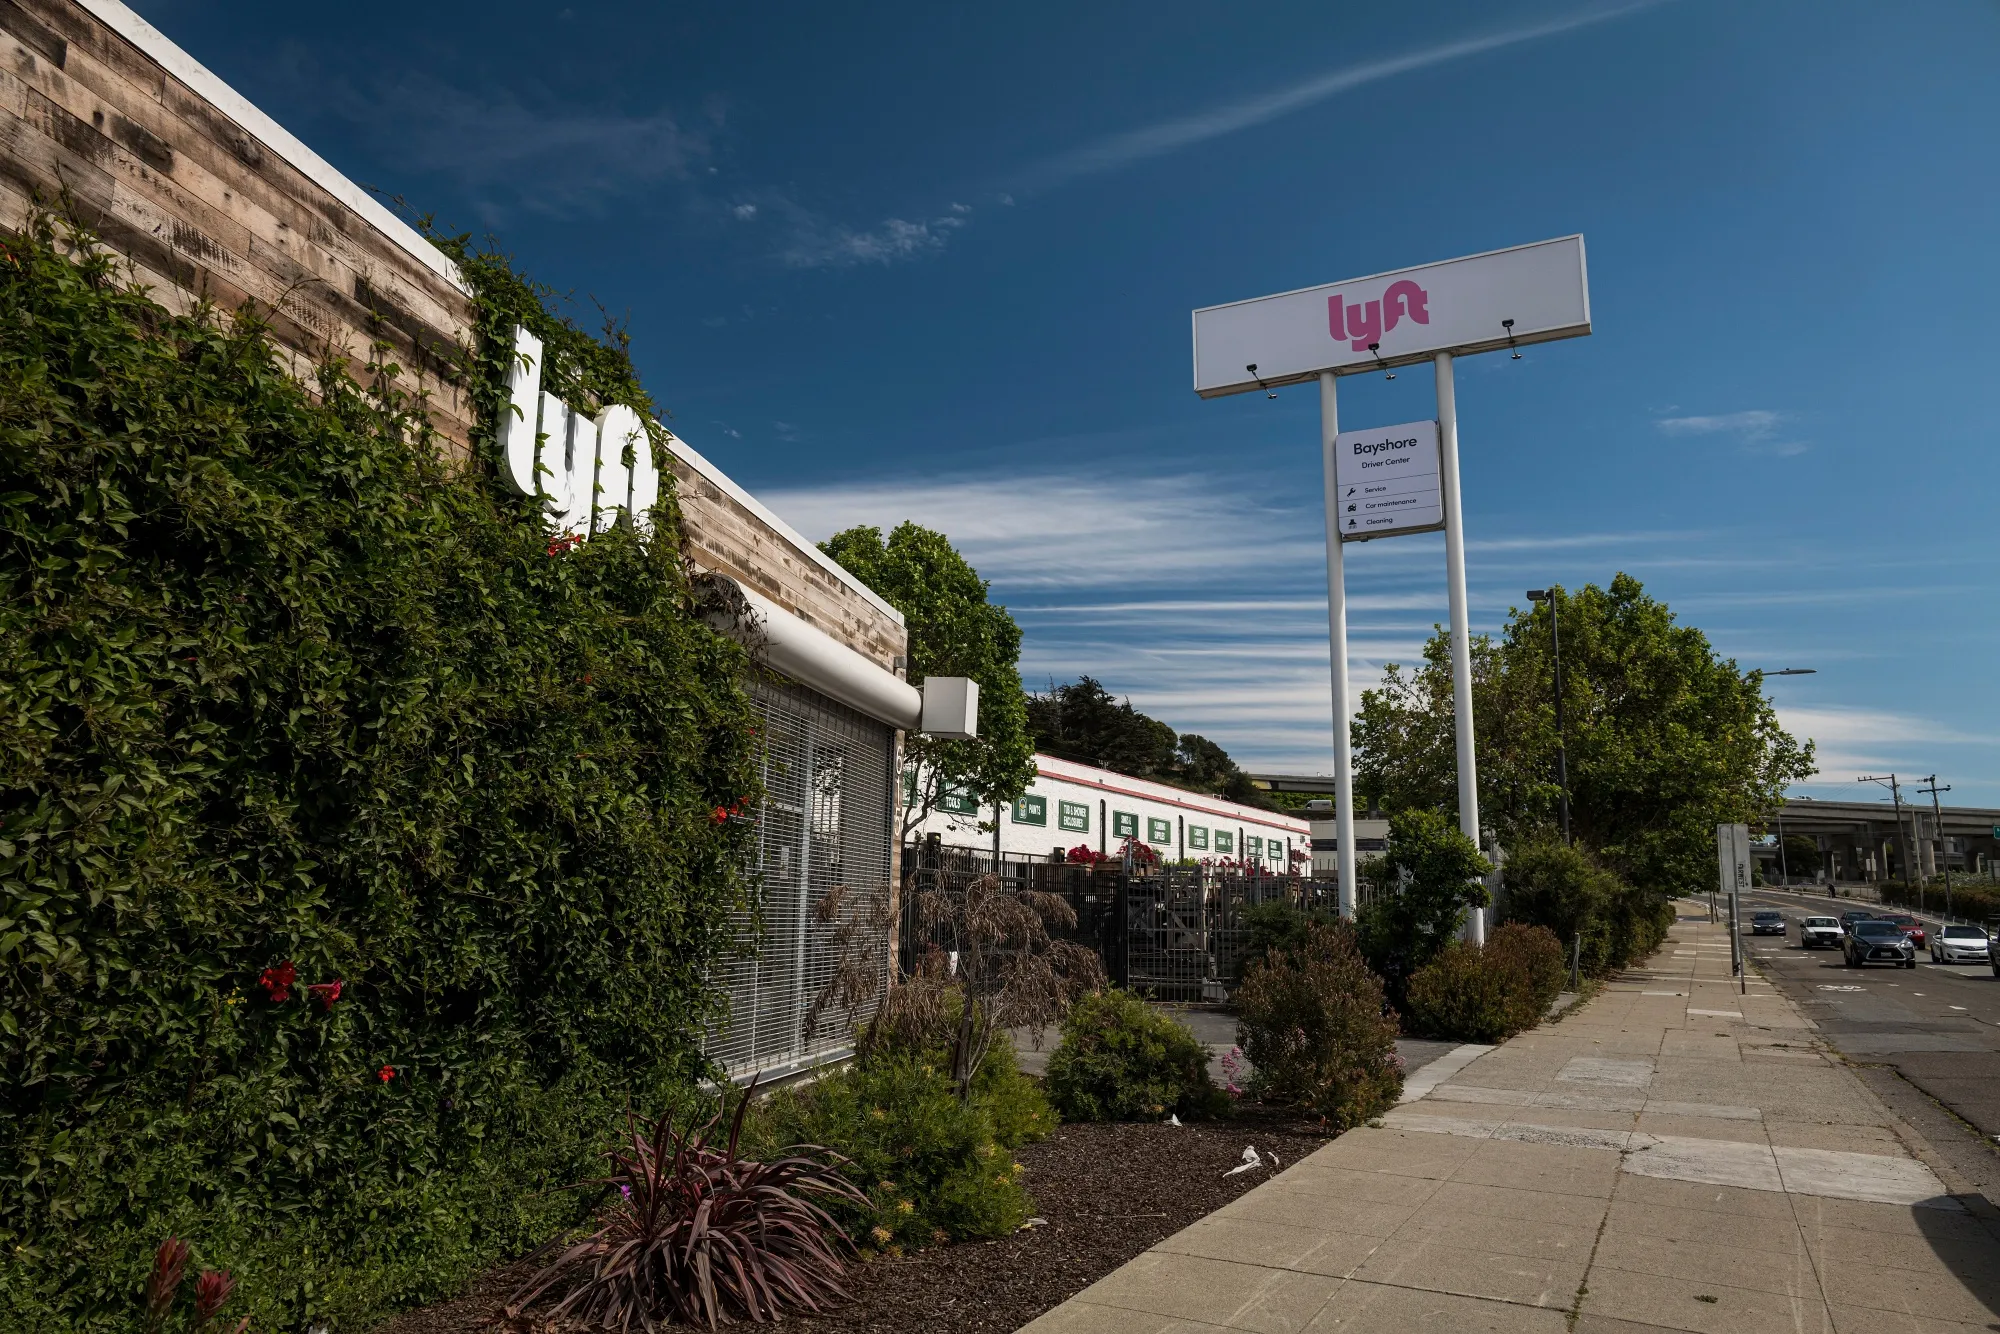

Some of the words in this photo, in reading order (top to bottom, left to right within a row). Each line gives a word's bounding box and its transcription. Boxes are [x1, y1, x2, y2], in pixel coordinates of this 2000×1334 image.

[1328, 280, 1429, 352] lyft
[1353, 438, 1417, 455] Bayshore
[1385, 457, 1410, 466] Center
[1378, 498, 1416, 508] maintenance
[1366, 517, 1393, 525] Cleaning
[894, 745, 903, 836] 615
[945, 796, 960, 809] TOOLS
